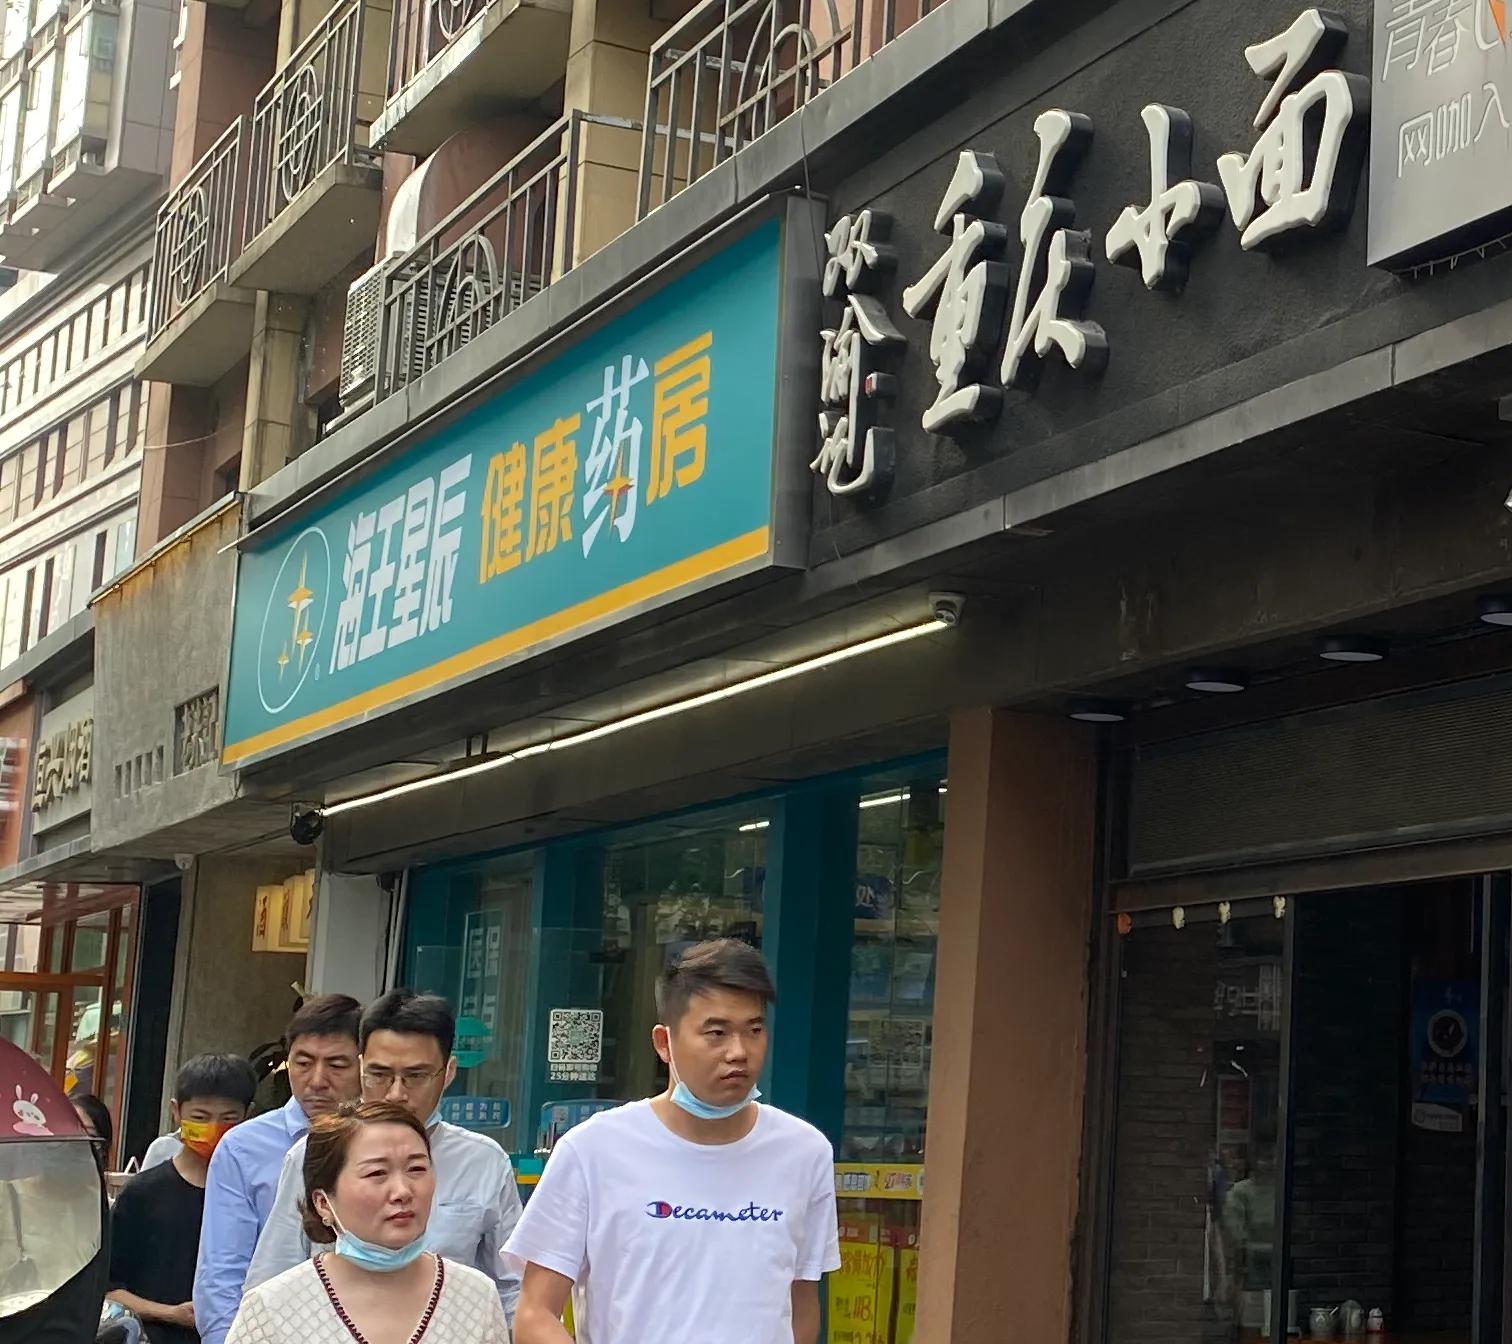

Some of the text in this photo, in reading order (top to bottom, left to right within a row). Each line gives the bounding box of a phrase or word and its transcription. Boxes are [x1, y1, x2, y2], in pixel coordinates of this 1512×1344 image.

[902, 8, 1360, 433] 重庆小面
[329, 331, 715, 675] 海王星辰 健康药房
[644, 1200, 784, 1222] Decameter
